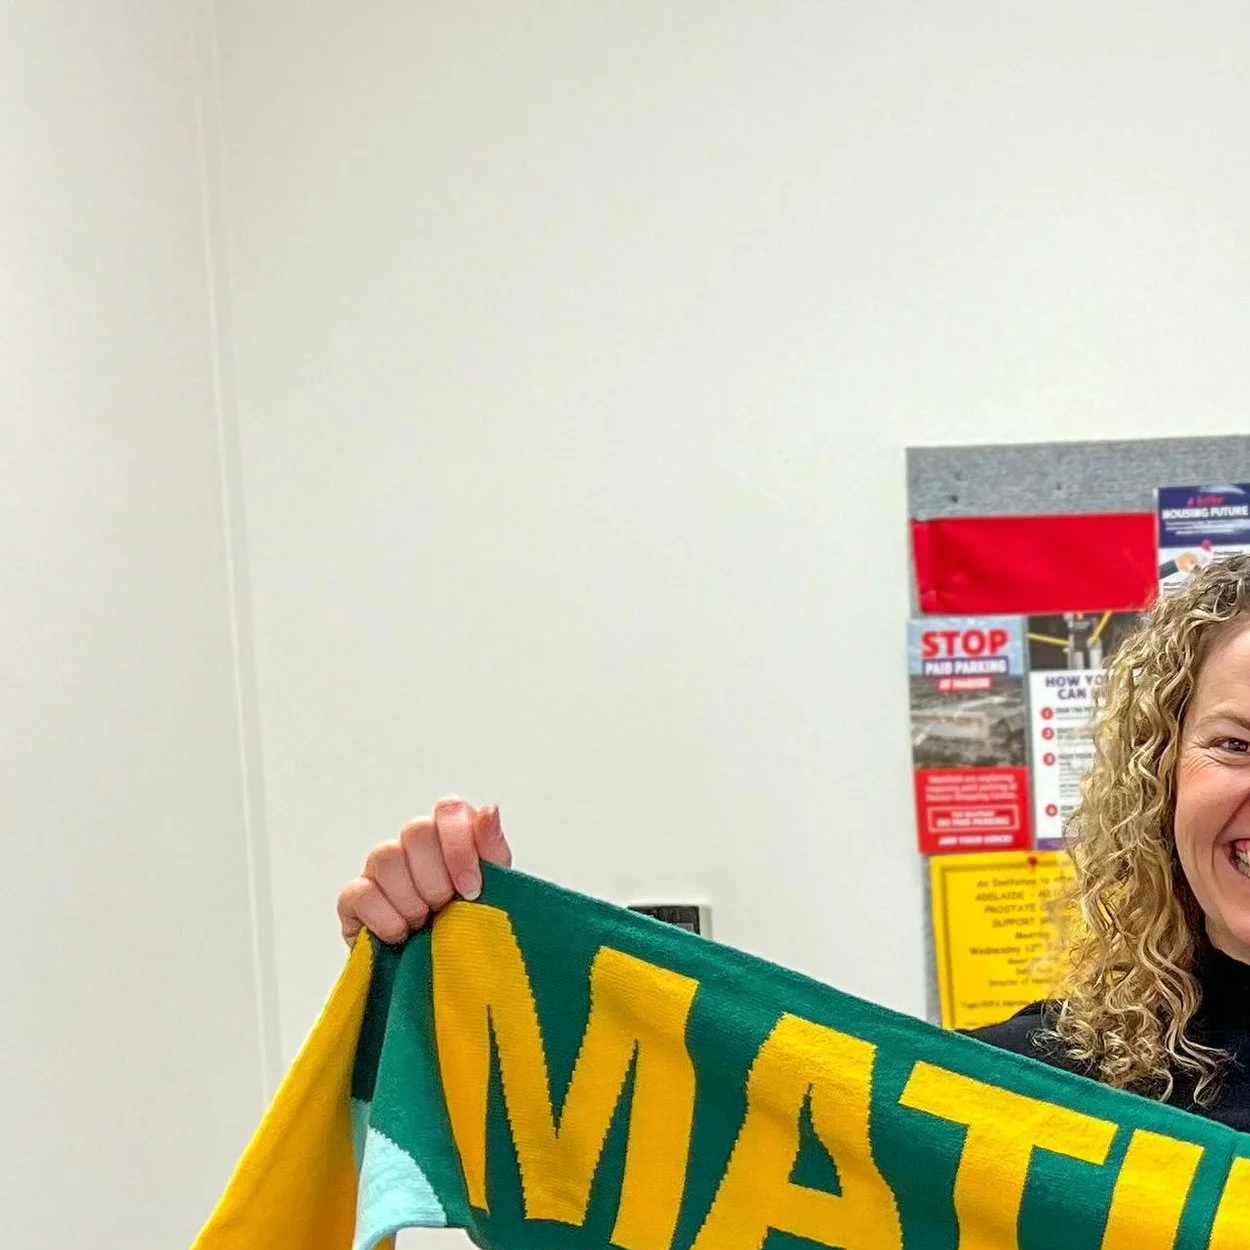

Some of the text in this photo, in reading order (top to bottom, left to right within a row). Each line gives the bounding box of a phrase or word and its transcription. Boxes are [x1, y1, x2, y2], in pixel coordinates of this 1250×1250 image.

[1162, 506, 1248, 520] HOUSING FUTURE
[921, 629, 1009, 658] STOP
[925, 659, 1007, 675] PAID PARKING
[1046, 676, 1079, 687] HOW
[1057, 688, 1086, 700] CAN
[975, 893, 1024, 901] ADELAIDE
[984, 904, 1036, 914] PROSTATE
[992, 918, 1035, 928] SUPPORT
[969, 945, 1020, 956] Wednesday
